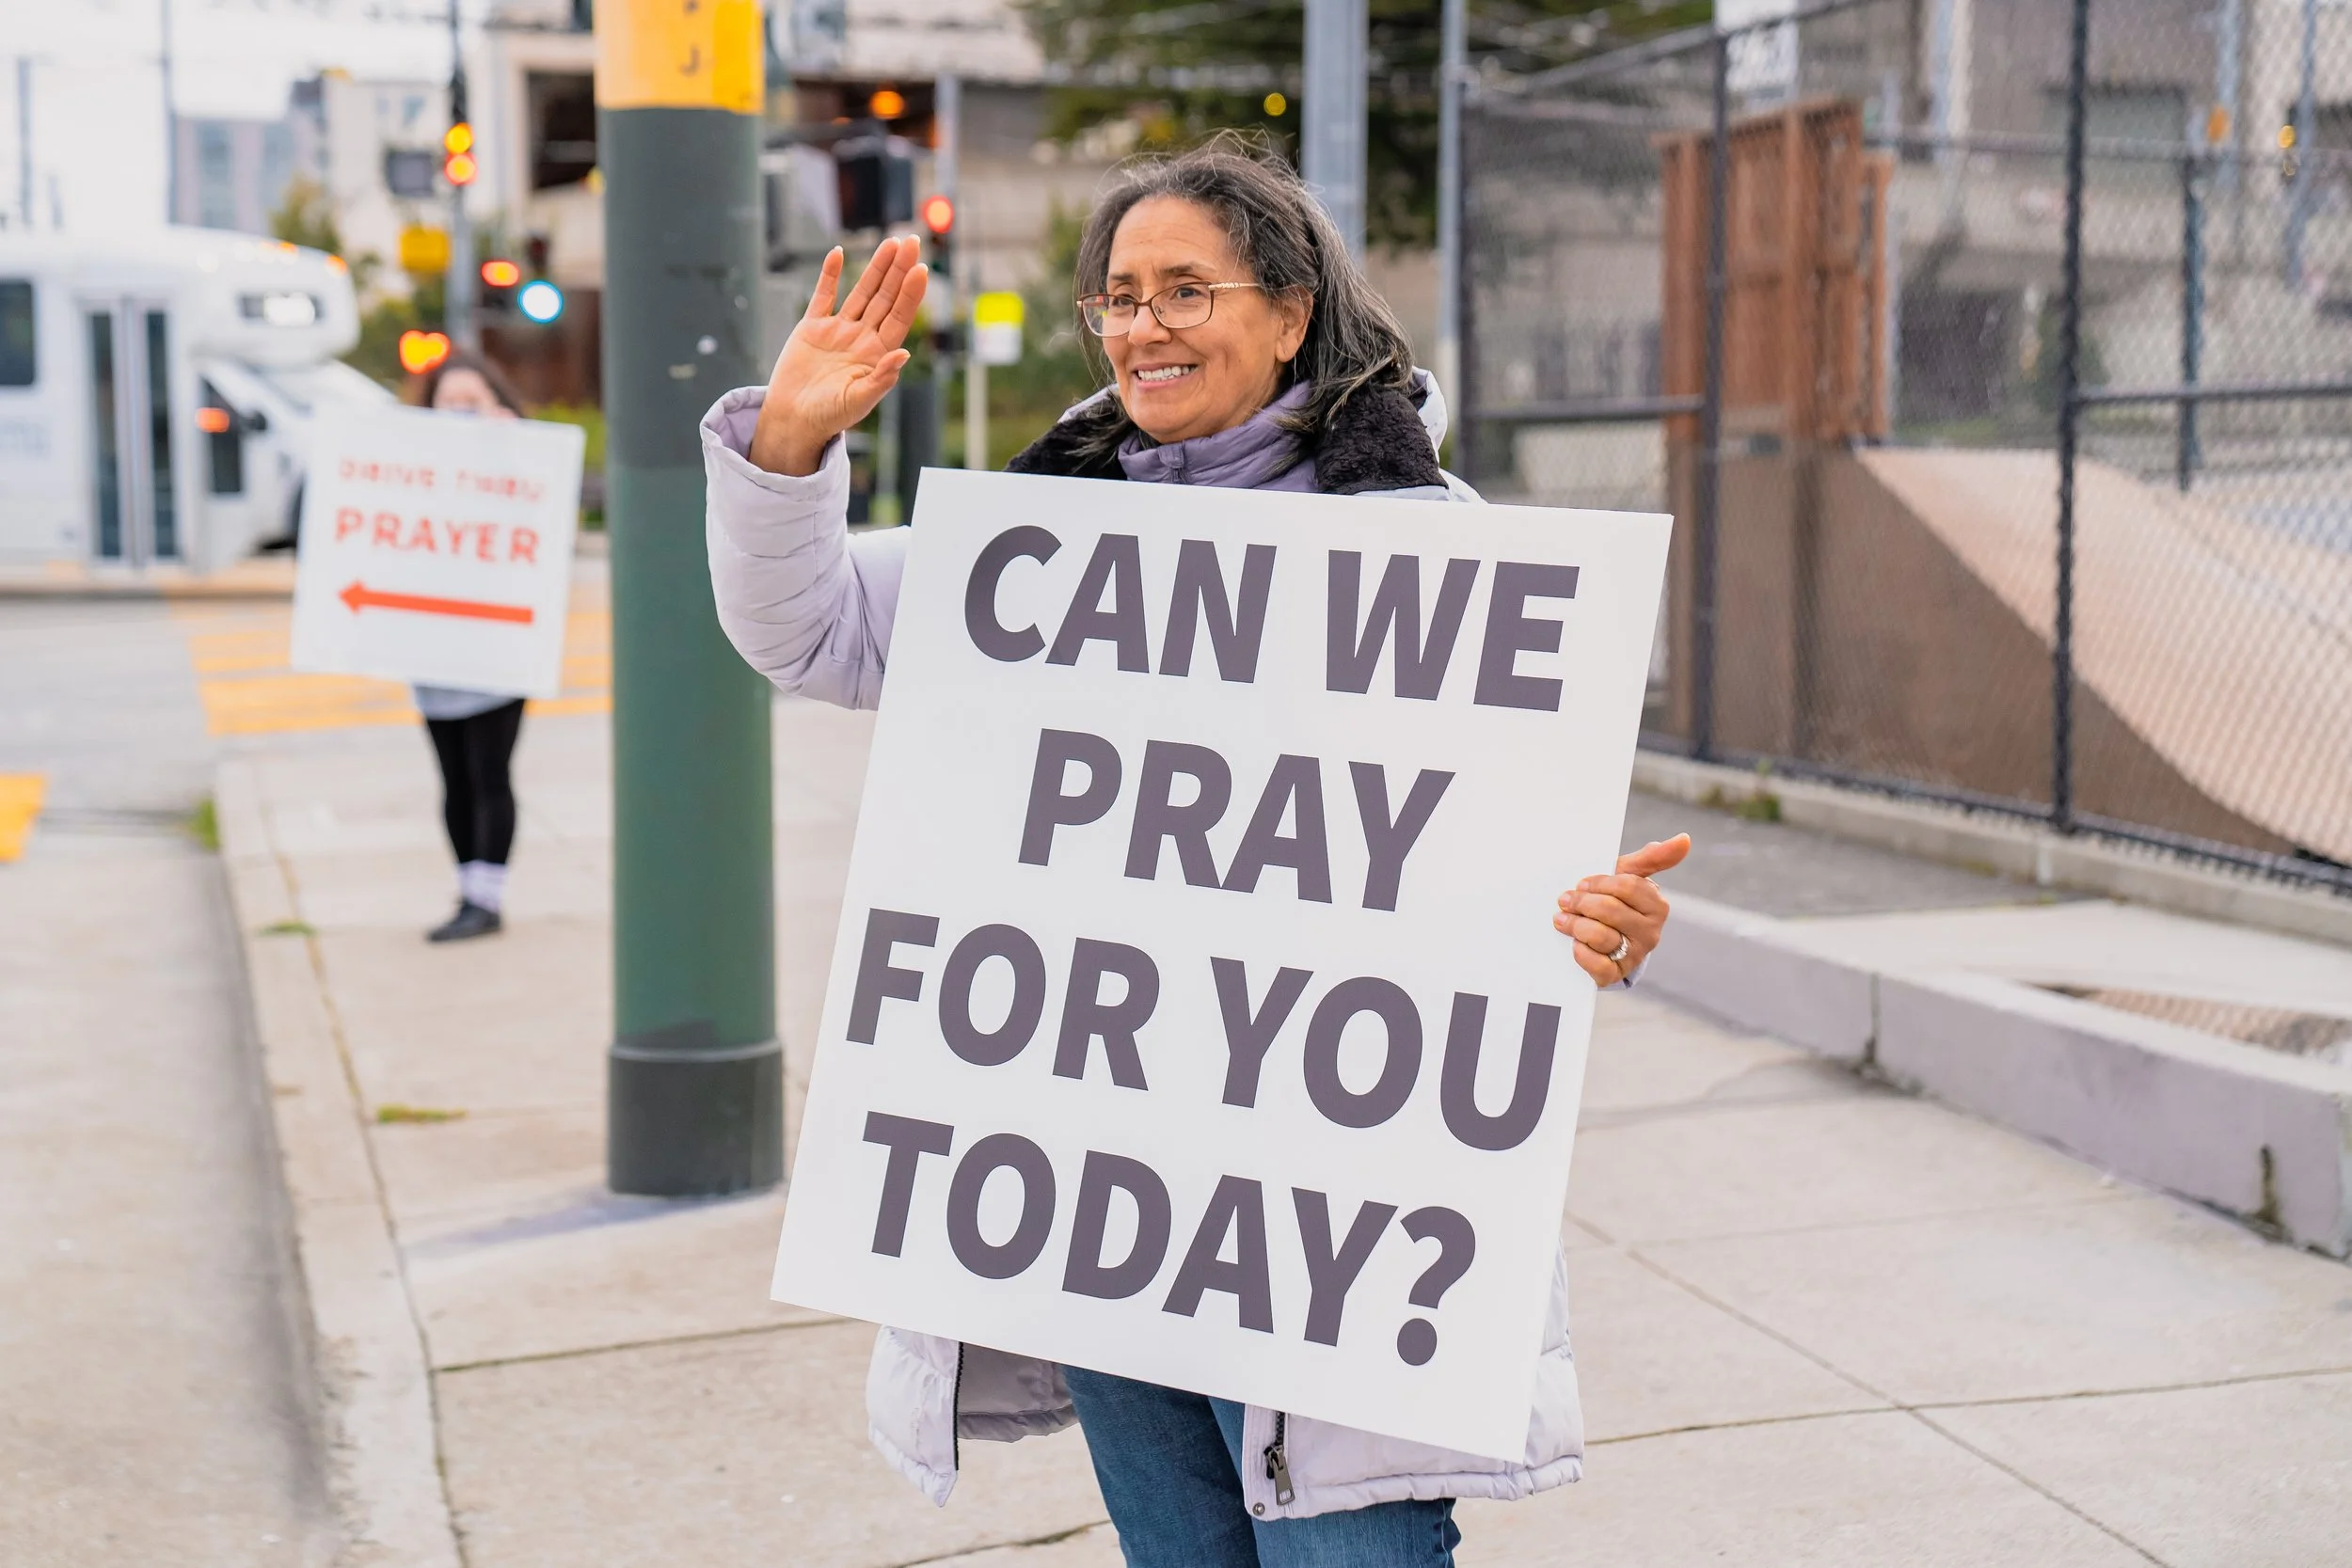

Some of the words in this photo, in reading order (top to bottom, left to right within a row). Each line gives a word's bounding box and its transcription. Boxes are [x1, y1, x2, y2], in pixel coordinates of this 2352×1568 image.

[334, 506, 540, 565] PRAYER
[965, 526, 1277, 683] CAN
[1327, 550, 1580, 712] WE
[1018, 728, 1455, 911] PRAY
[846, 908, 1159, 1091] FOR
[1210, 957, 1561, 1150] YOU
[863, 1111, 1475, 1366] TODAY?
